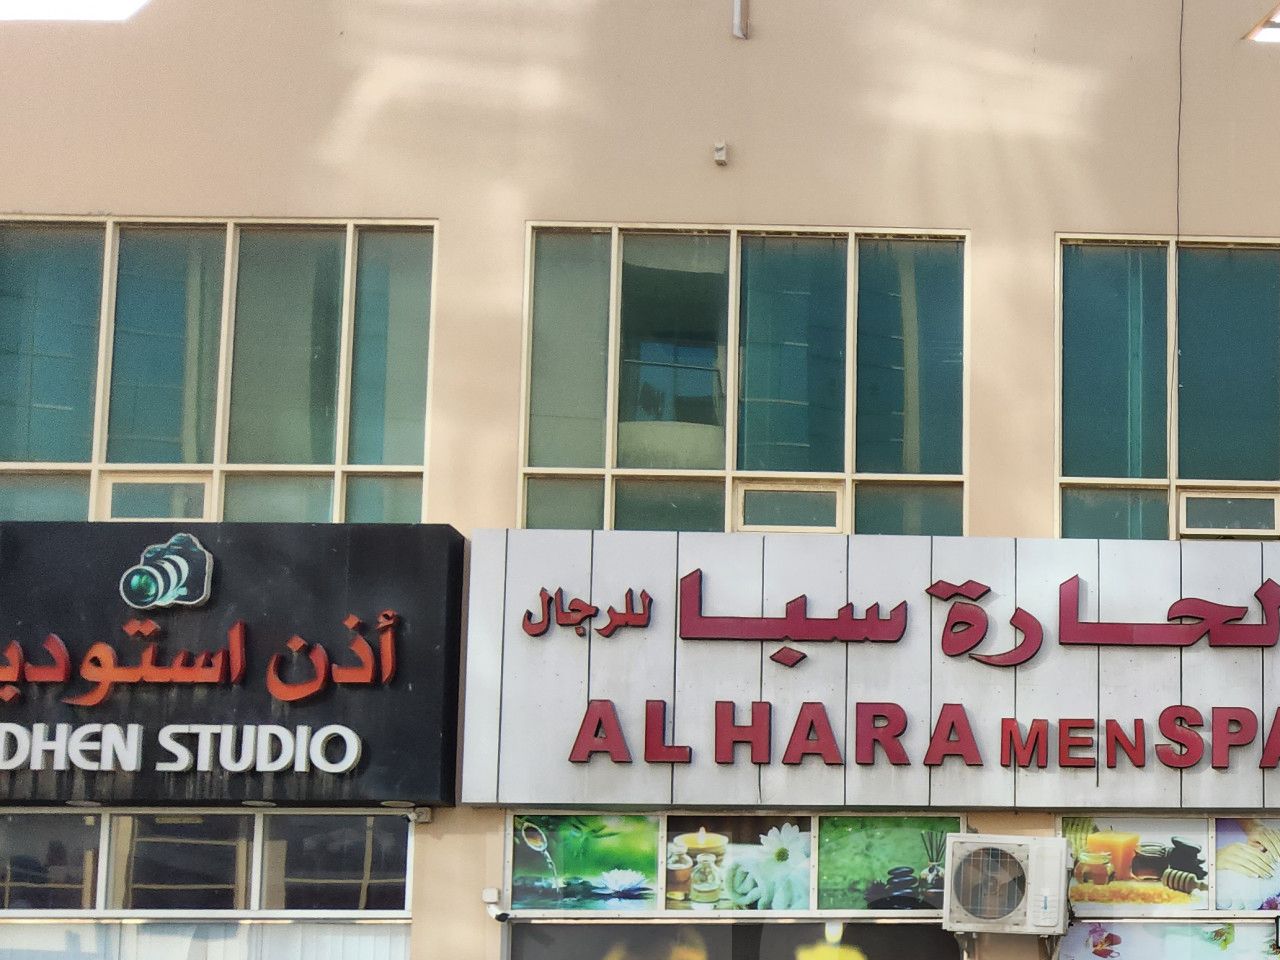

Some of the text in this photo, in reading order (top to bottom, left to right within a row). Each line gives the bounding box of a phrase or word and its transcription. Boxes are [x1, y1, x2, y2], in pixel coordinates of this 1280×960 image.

[521, 586, 653, 638] للرجال
[265, 608, 400, 702] أذن
[155, 723, 363, 774] STUDIO
[568, 699, 693, 763] AL
[715, 700, 984, 768] HARA
[1001, 717, 1146, 769] MEN
